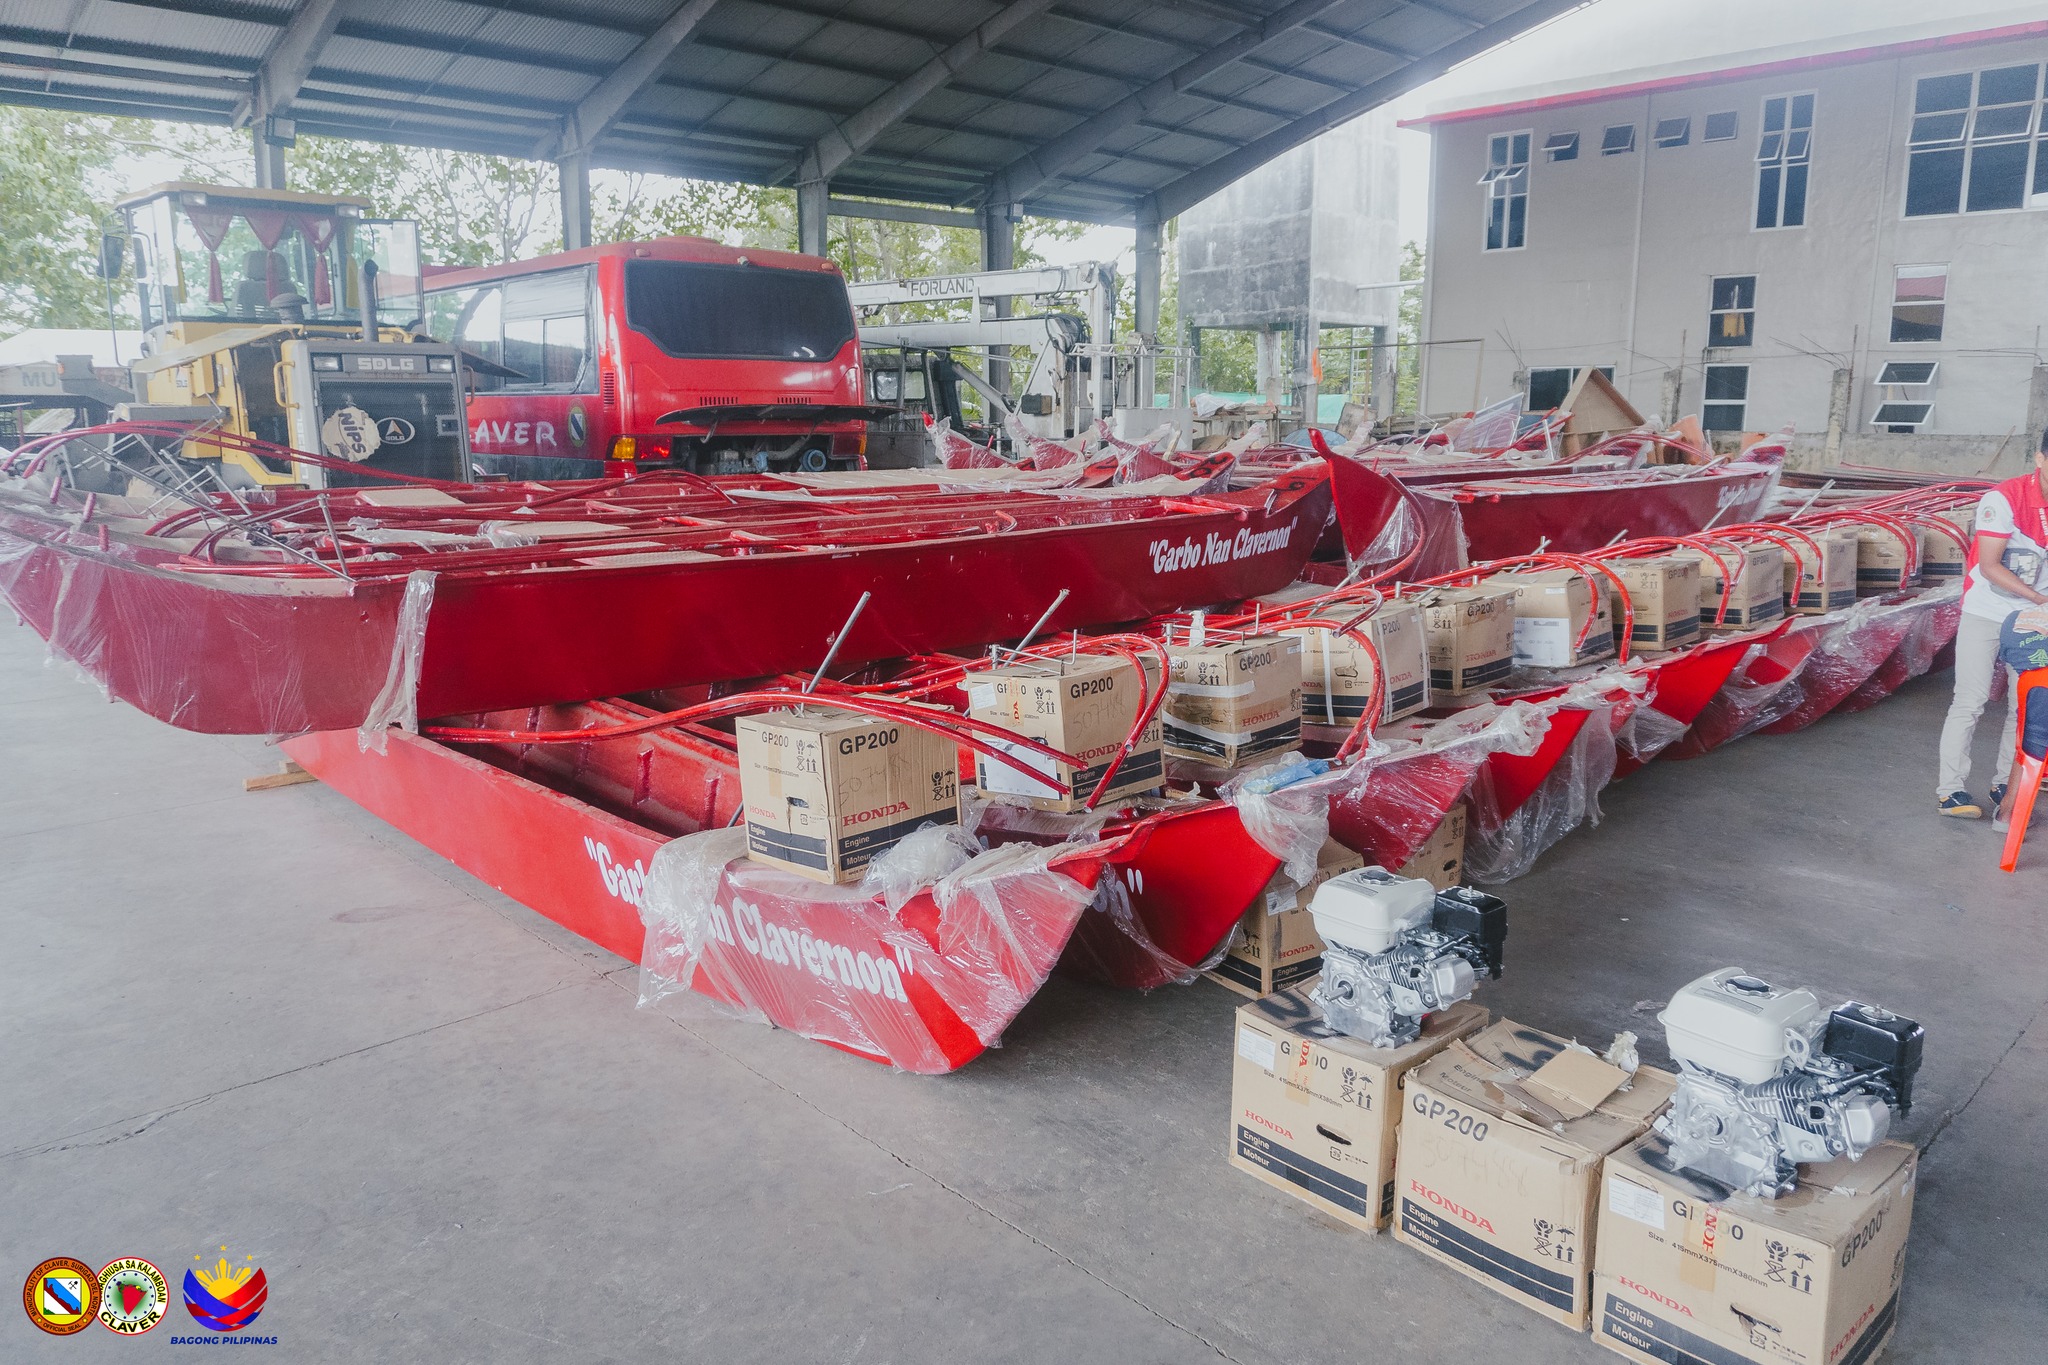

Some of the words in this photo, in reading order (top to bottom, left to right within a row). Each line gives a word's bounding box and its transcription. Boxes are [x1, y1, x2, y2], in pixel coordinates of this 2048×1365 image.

[911, 278, 974, 296] FORLAND
[357, 357, 415, 370] SDLG
[1149, 535, 1201, 574] "Garbo
[1202, 532, 1232, 567] Nan
[1232, 516, 1298, 561] Clavernon"
[1467, 602, 1495, 617] GP200
[1240, 652, 1272, 671] GP200
[1070, 676, 1114, 699] GP200
[1242, 710, 1280, 727] HONDA
[762, 731, 789, 748] GP200
[839, 728, 899, 755] GP200
[1076, 770, 1096, 780] Engine
[750, 805, 777, 820] HONDA
[843, 801, 910, 827] HONDA
[751, 824, 766, 836] Engine
[751, 840, 768, 852] Moteur
[844, 835, 870, 849] Engine
[846, 852, 872, 865] Moteur
[731, 897, 914, 1003] Clavernon"
[1279, 944, 1316, 960] HONDA
[1277, 966, 1298, 977] Engine
[1245, 1109, 1294, 1141] HONDA
[1413, 1093, 1489, 1142] GP200
[1243, 1130, 1270, 1150] Engine
[1243, 1147, 1270, 1167] Moteur
[1409, 1204, 1439, 1228] Engine
[1411, 1179, 1497, 1235] HONDA
[1408, 1222, 1439, 1246] Moteur
[1841, 1209, 1883, 1268] GP200
[1672, 1242, 1768, 1288] 415mmX375mmX380mm
[1619, 1275, 1694, 1318] HONDA
[1615, 1302, 1654, 1329] Engine
[1611, 1323, 1652, 1350] Moteur
[1830, 1303, 1875, 1362] HONDA
